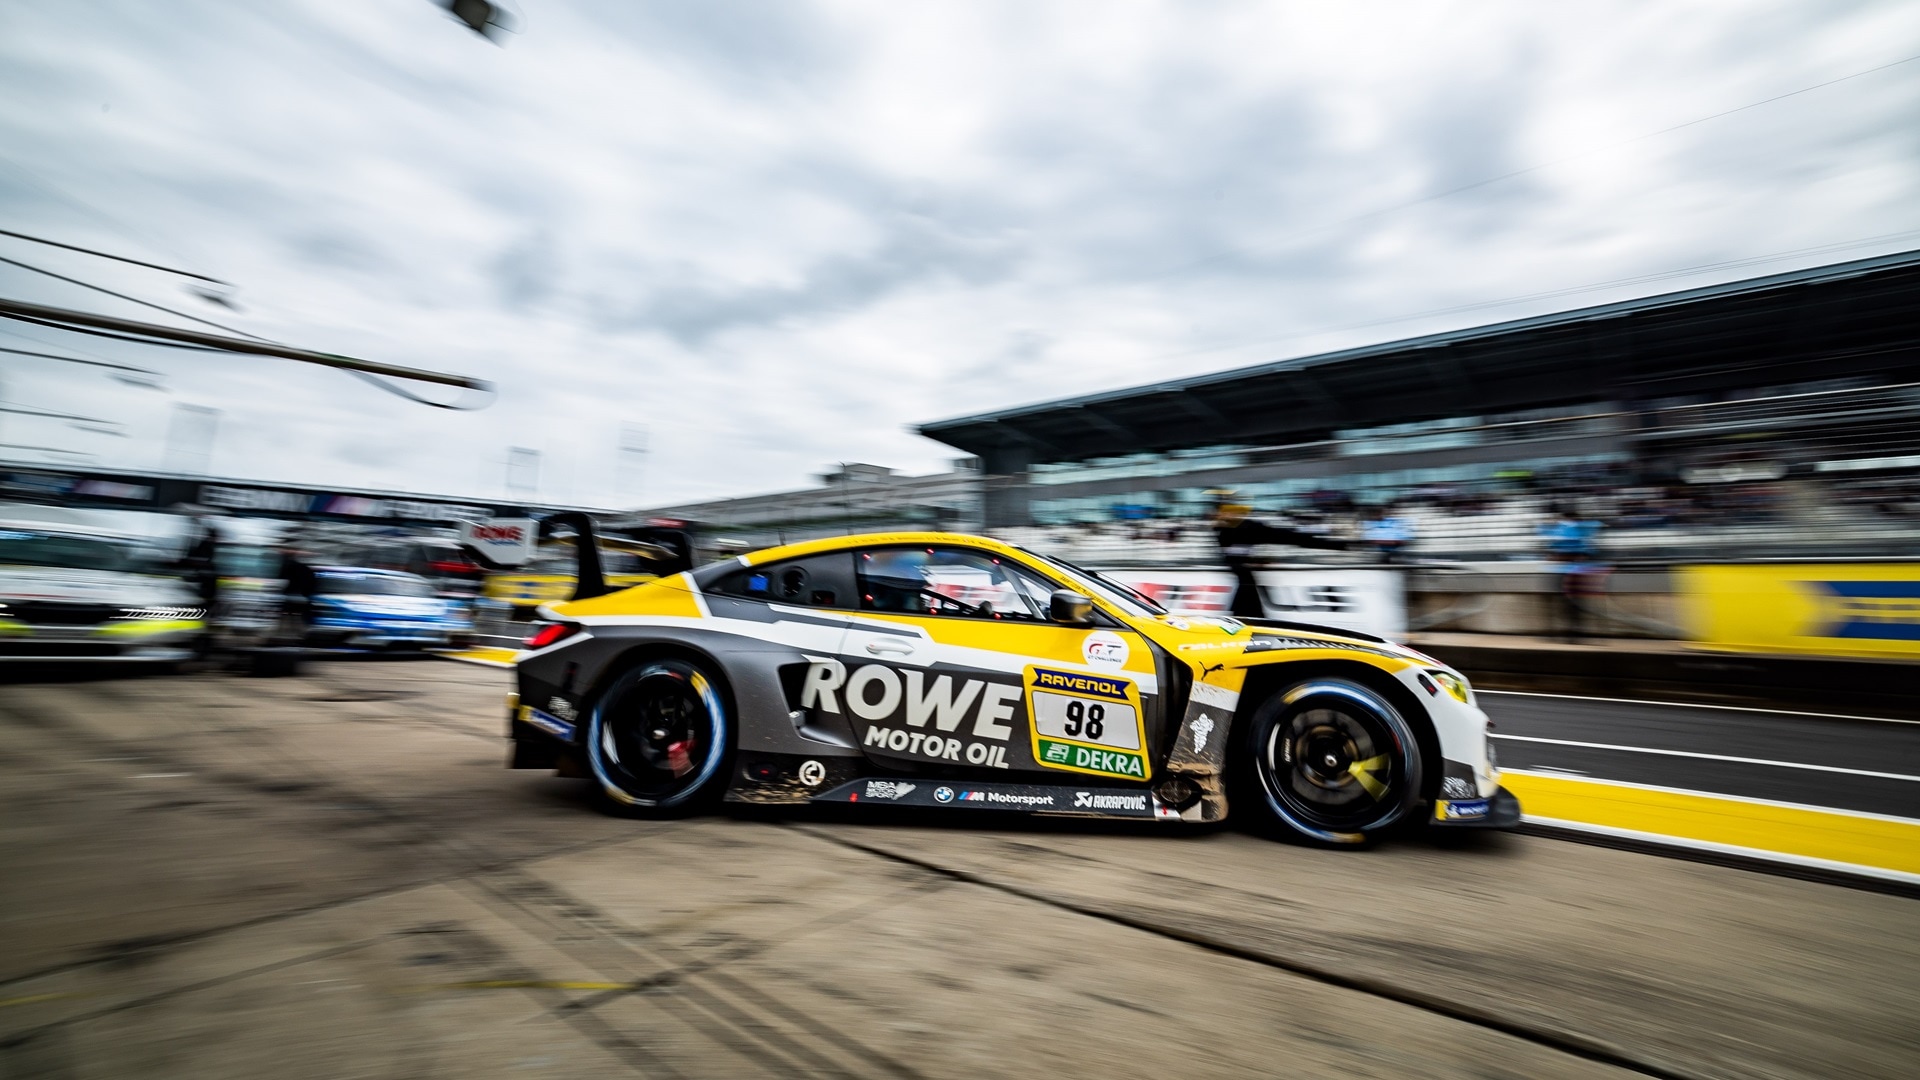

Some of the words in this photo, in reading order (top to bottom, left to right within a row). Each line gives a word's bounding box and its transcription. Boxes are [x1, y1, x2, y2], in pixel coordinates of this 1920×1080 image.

[801, 654, 1023, 741] ROWE
[1040, 672, 1122, 695] RAVENOL
[1064, 700, 1105, 740] 98
[864, 725, 962, 761] MOTOR
[965, 742, 1010, 769] OIL
[1075, 747, 1143, 776] DEKRA
[987, 791, 1055, 806] Motorsport
